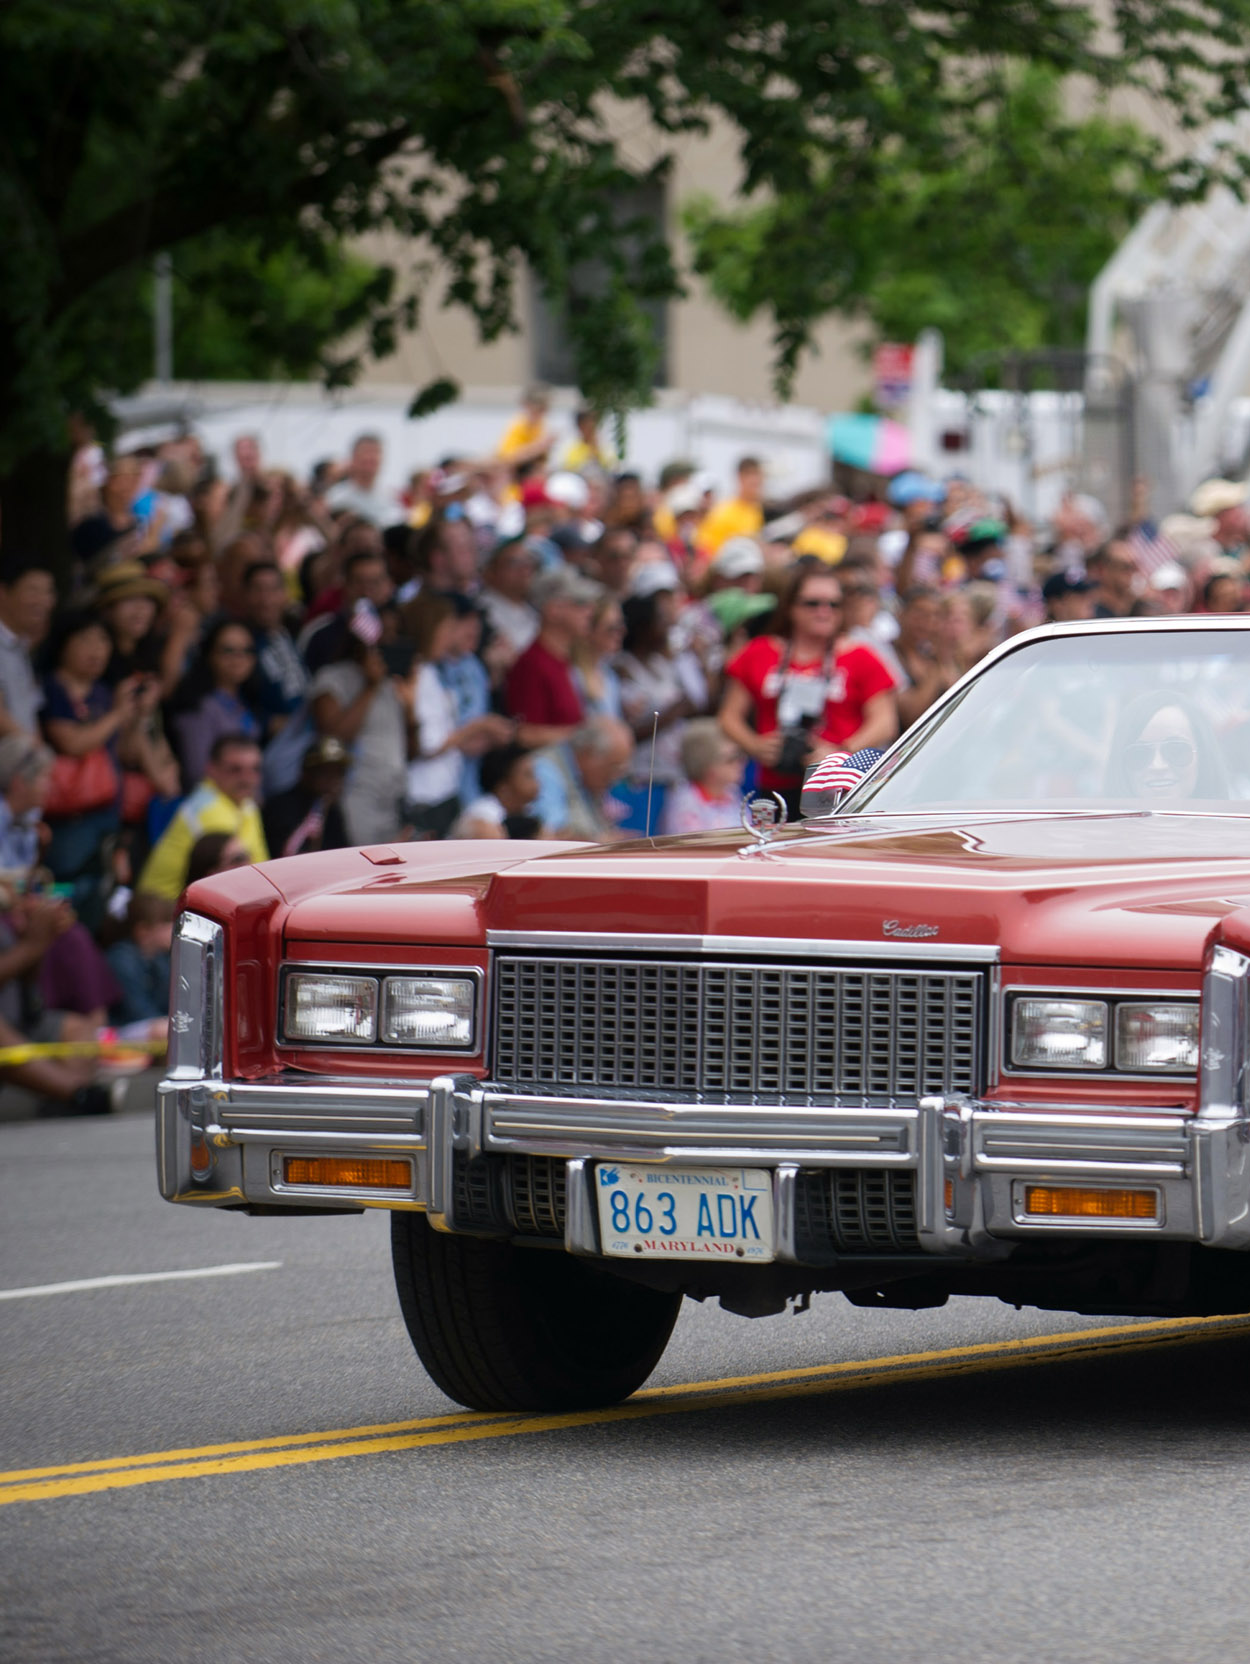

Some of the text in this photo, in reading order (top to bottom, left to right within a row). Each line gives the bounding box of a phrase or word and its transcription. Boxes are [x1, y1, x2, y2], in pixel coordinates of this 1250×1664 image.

[882, 919, 939, 938] Cadillac
[646, 1173, 728, 1187] BICENTENNIAL
[610, 1190, 761, 1240] 863 ADK
[643, 1239, 735, 1254] MARYLAND
